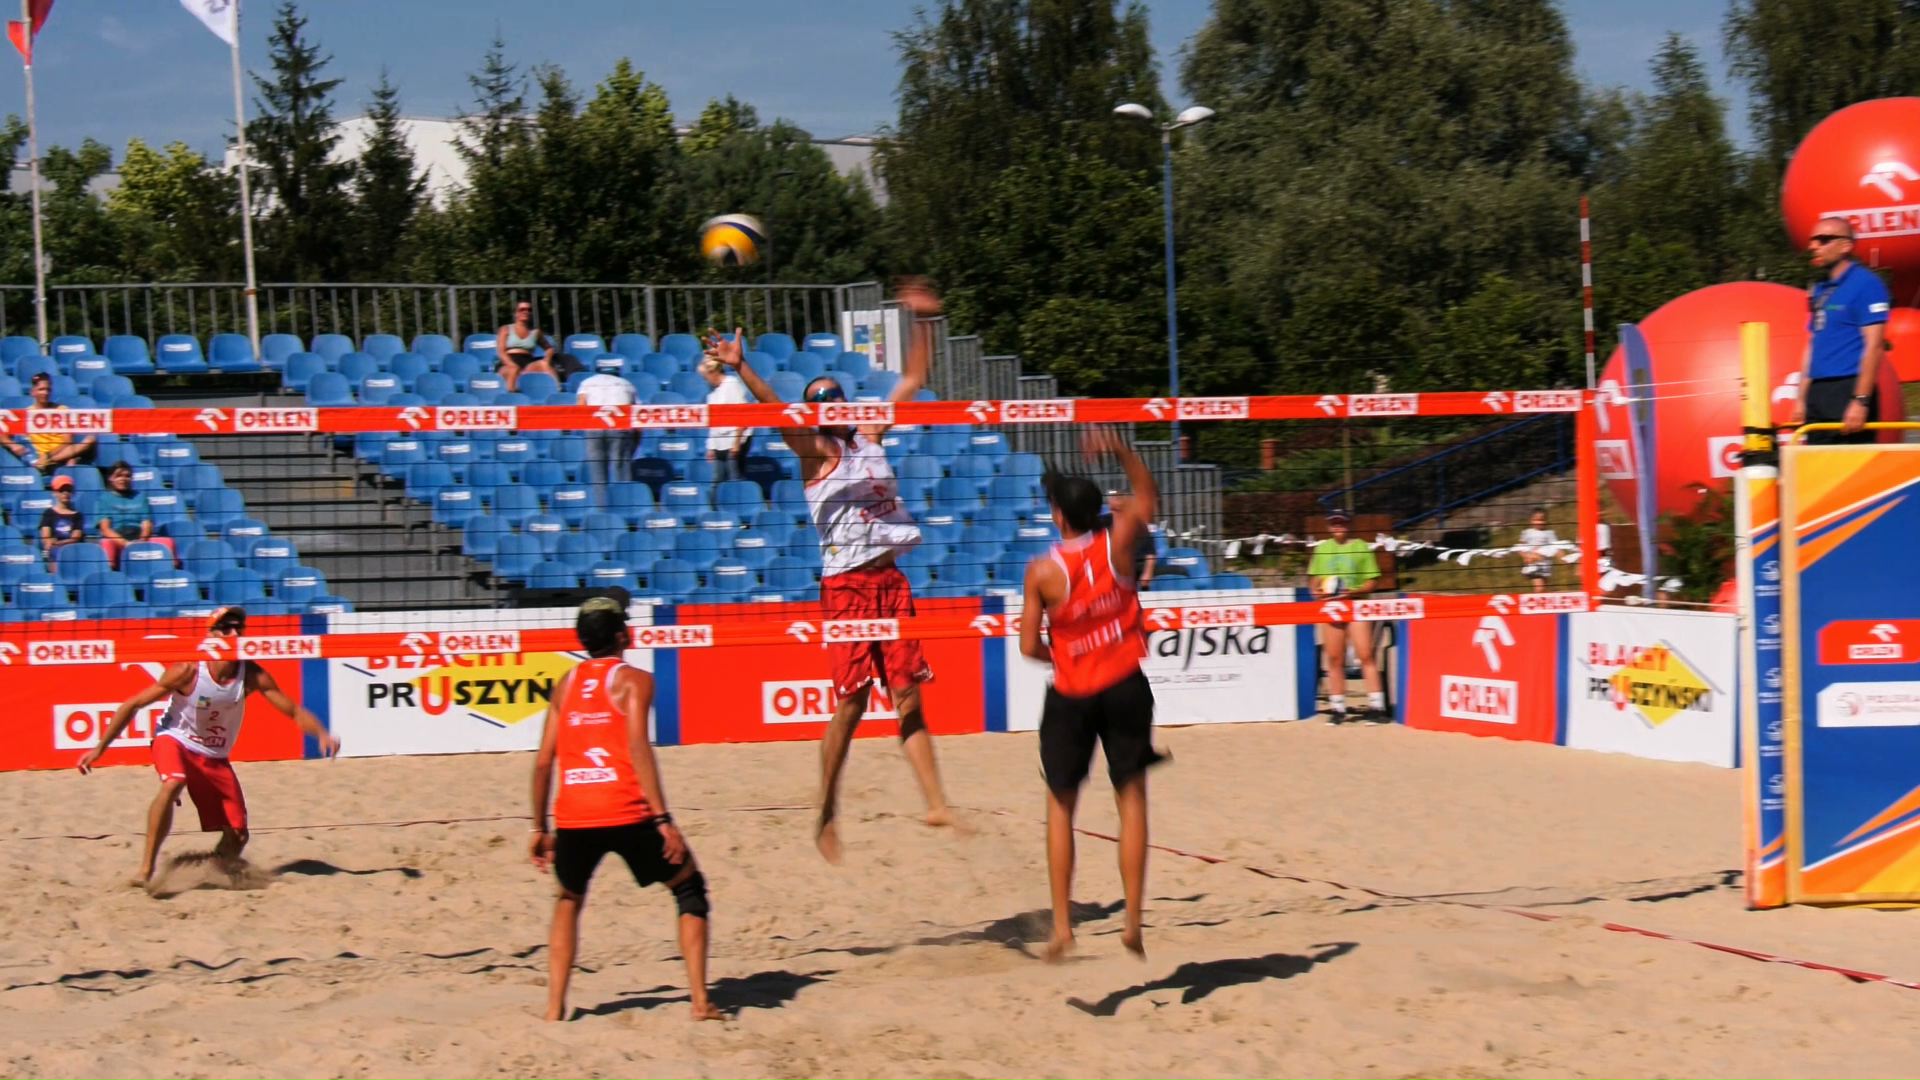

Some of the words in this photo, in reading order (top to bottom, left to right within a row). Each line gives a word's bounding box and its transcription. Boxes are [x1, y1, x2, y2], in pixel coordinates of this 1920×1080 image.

[1849, 209, 1919, 235] RLEN
[823, 404, 888, 422] ORLEN
[1005, 401, 1068, 419] ORLEN
[1181, 400, 1244, 416] ORLEN
[1350, 396, 1412, 413] ORLEN
[32, 412, 105, 429] ORLEN
[240, 411, 311, 428] ORLEN
[441, 408, 510, 426] ORLEN
[637, 406, 702, 424] ORLEN
[1356, 601, 1418, 618] ORLEN
[1522, 595, 1584, 613] ORLEN
[1187, 610, 1248, 625] ORLEN
[639, 628, 705, 645] ORLEN
[827, 622, 892, 639] ORLEN
[243, 639, 314, 656] ORLEN
[445, 633, 513, 651] ORLEN
[1157, 625, 1270, 671] ajska
[34, 643, 107, 661] ORLEN
[1588, 642, 1671, 671] BLACHY
[368, 672, 552, 715] PRUSZYŃ
[581, 679, 599, 699] 2
[773, 686, 896, 716] ORLN
[1448, 682, 1511, 716] ORLEN
[209, 710, 220, 721] 2
